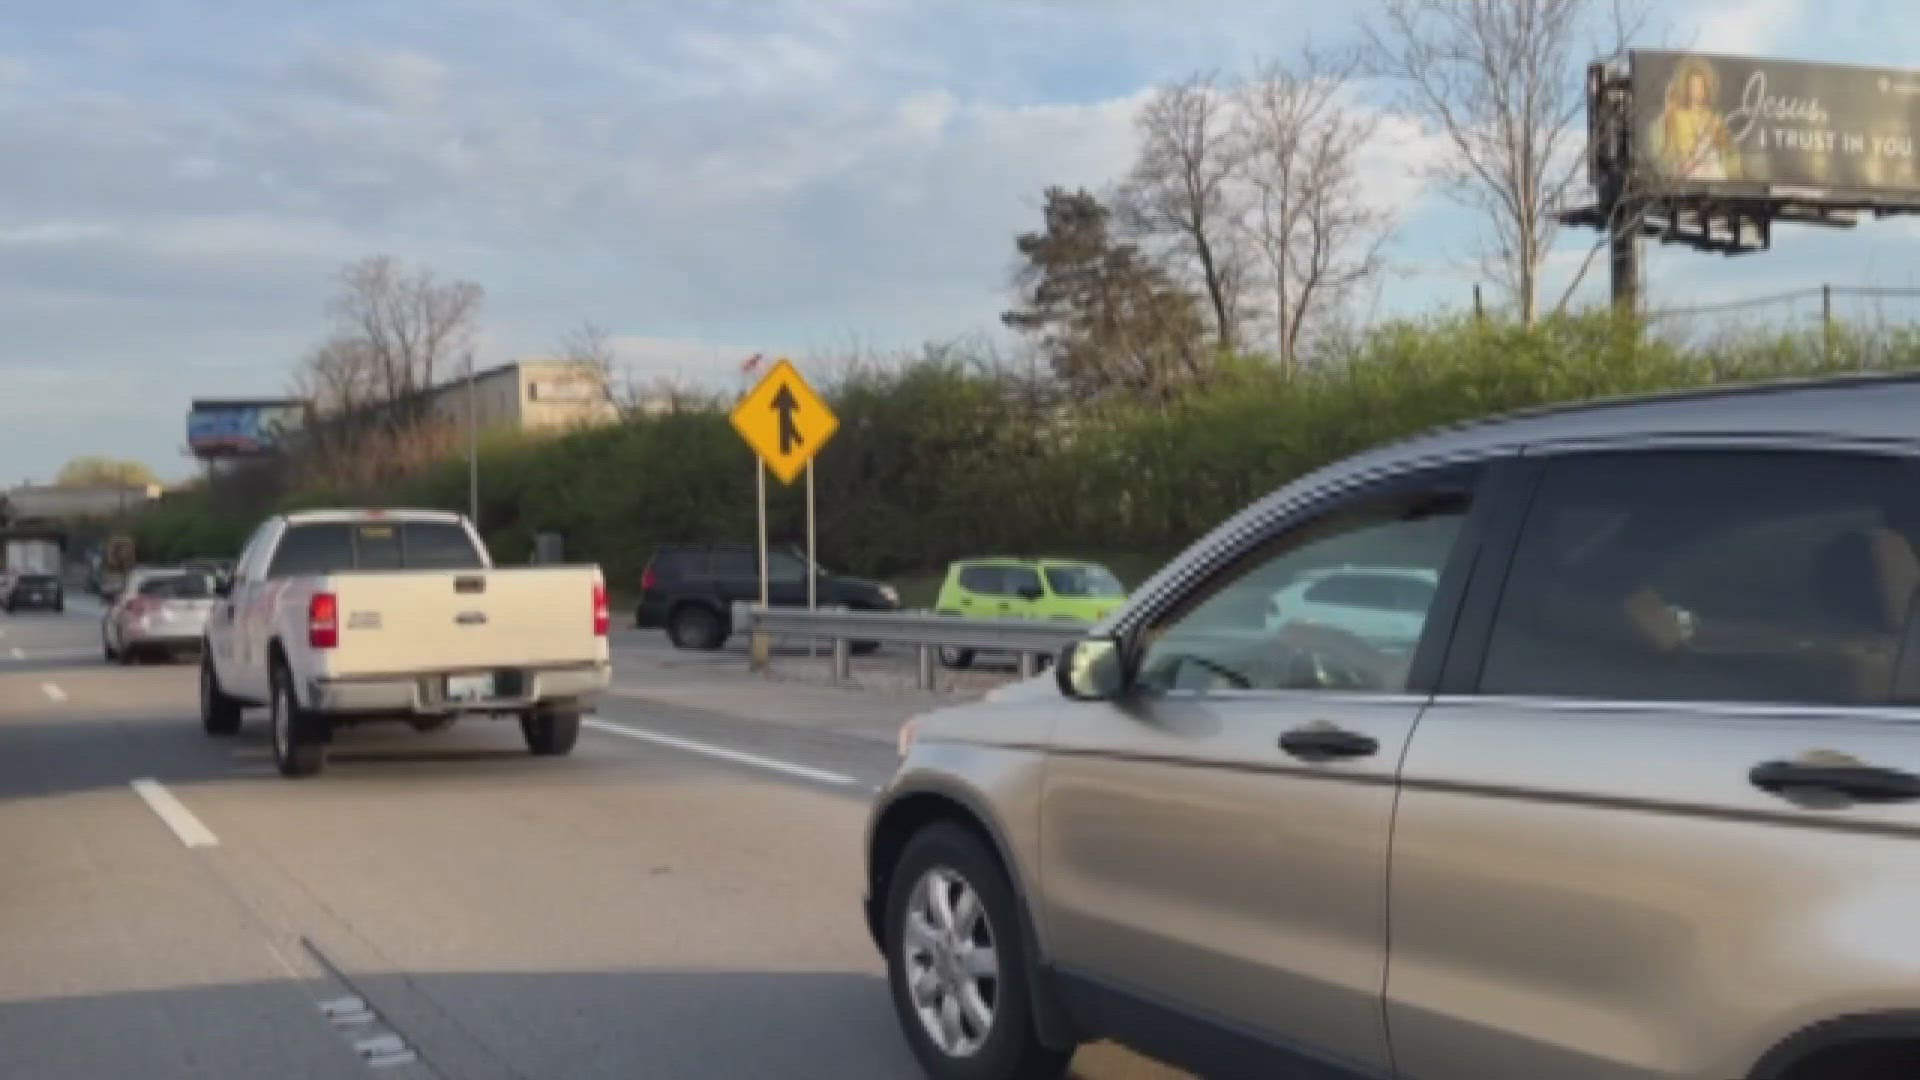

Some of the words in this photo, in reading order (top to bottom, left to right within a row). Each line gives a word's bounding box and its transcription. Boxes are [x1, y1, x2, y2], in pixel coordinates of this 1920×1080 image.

[1774, 128, 1835, 152] TRUST
[1841, 132, 1863, 153] IN
[1871, 136, 1912, 157] YOU
